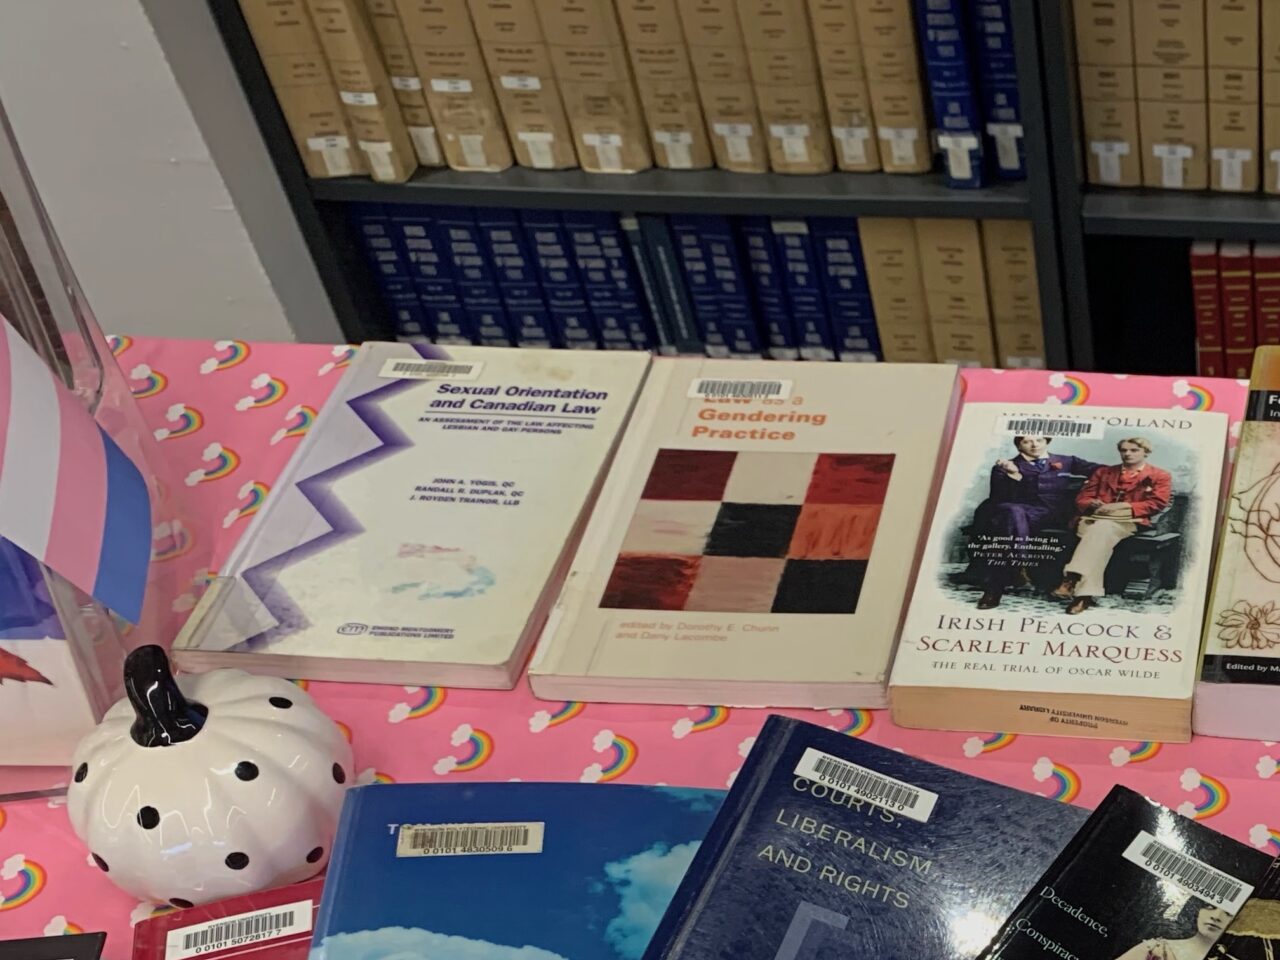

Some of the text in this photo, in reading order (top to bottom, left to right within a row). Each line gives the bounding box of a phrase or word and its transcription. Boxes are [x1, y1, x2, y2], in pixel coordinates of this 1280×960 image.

[436, 383, 608, 401] Sexual Orientation
[429, 399, 601, 415] and Canadian Law
[697, 408, 827, 426] Gendering
[691, 425, 795, 441] Practice
[937, 615, 1173, 640] IRISH PEACOCK &
[916, 635, 1183, 664] SCARLET MARQUESS
[931, 661, 1161, 679] THE REAL TRIAL OF OSCAR WILDE
[1226, 663, 1255, 671] Edited
[1256, 664, 1268, 674] by
[775, 809, 932, 876] LIBERALISM
[758, 844, 910, 909] AND RIGHTS
[1040, 885, 1110, 938] Decadence,
